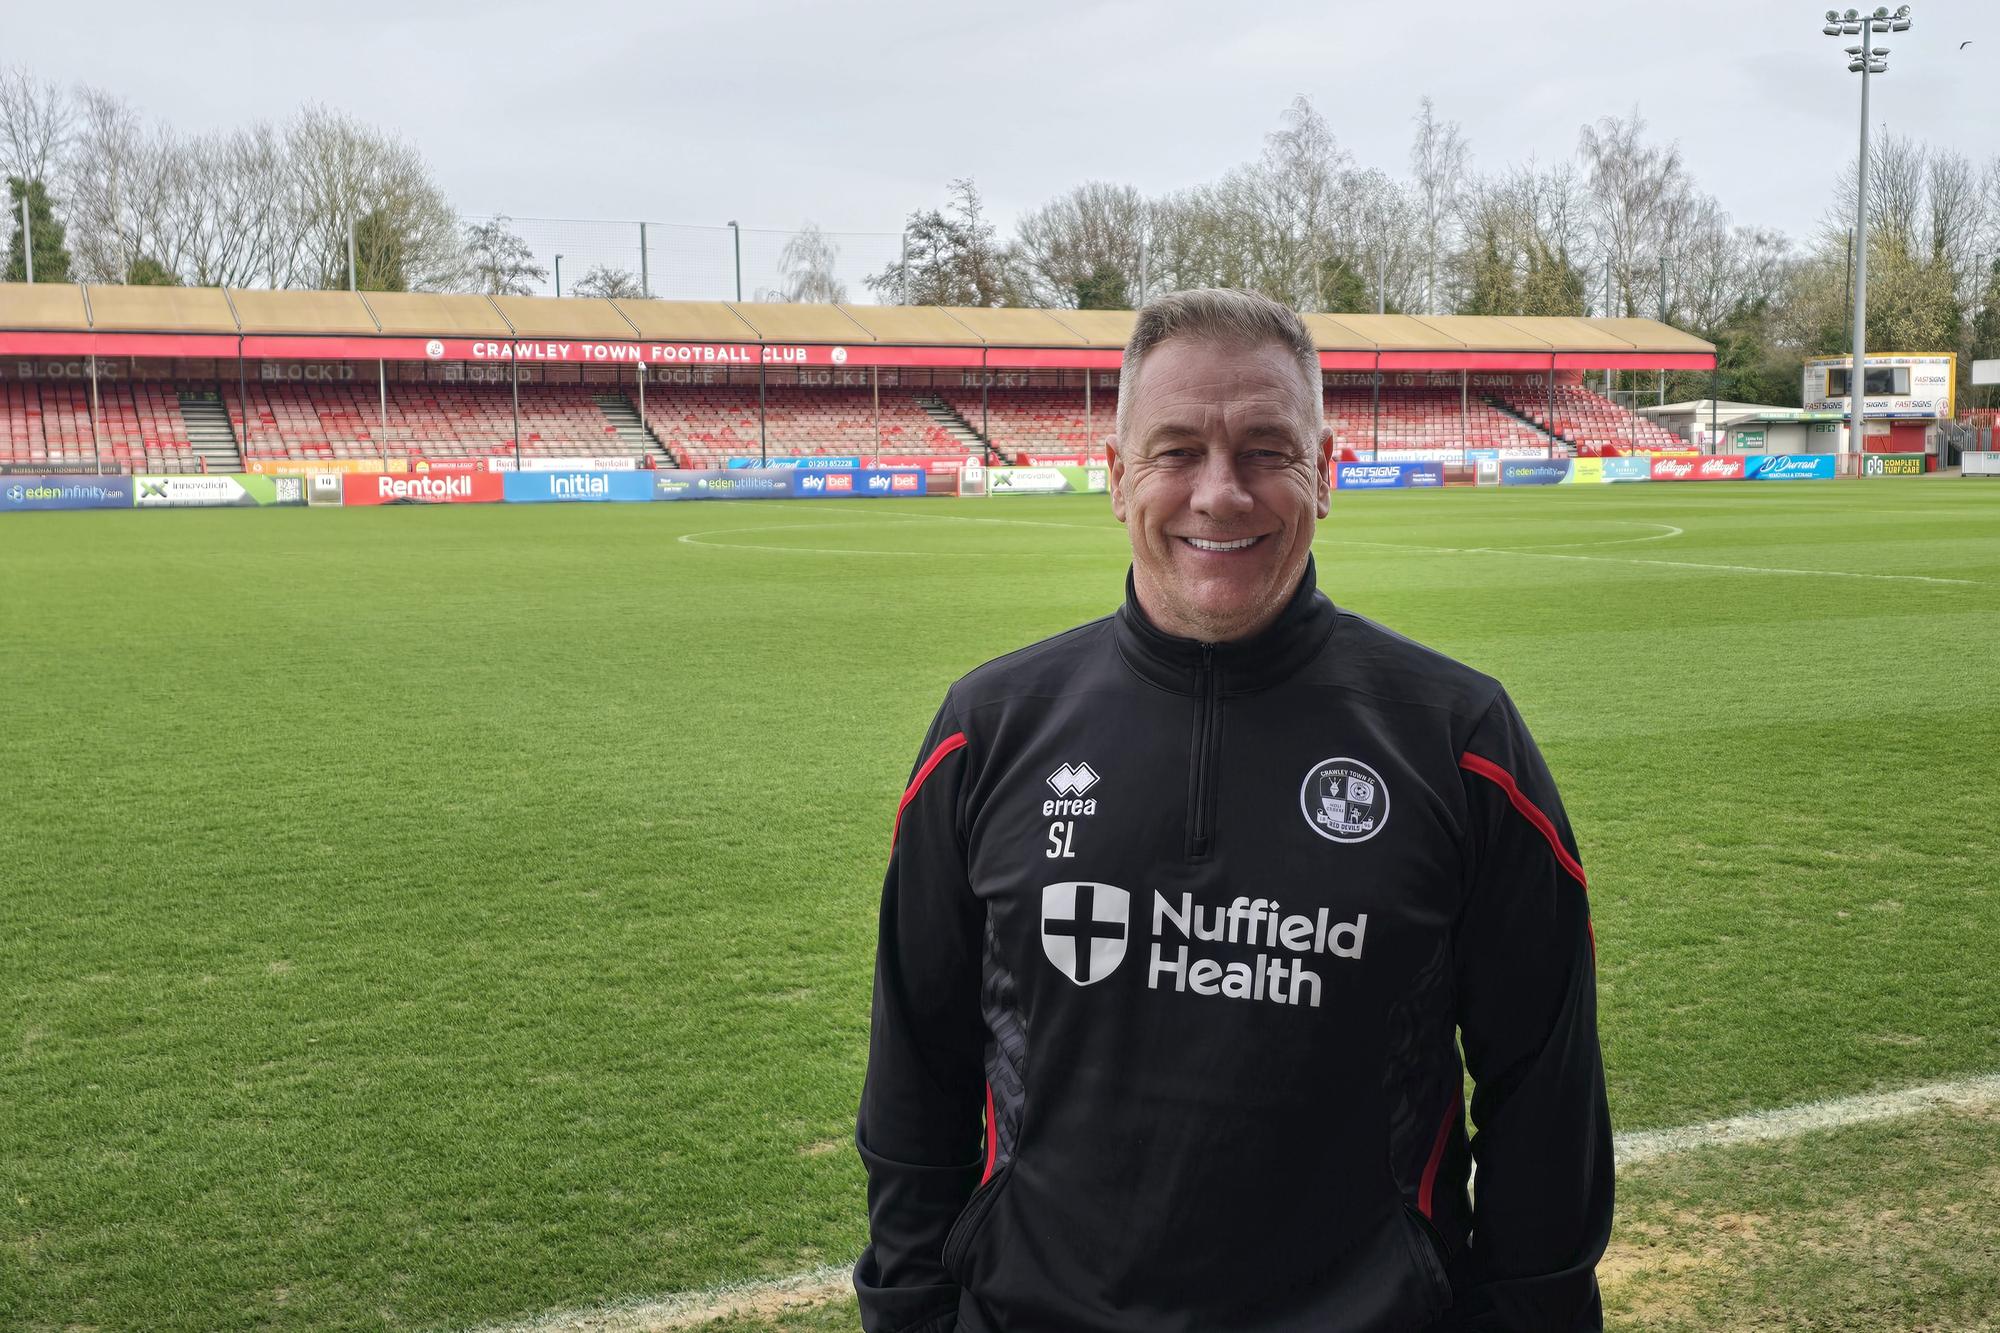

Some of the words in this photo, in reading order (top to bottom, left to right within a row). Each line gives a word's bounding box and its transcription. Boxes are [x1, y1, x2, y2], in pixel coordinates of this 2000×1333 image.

[473, 343, 570, 358] CRAWLEY
[582, 344, 640, 359] TOWN
[652, 346, 750, 361] FOOTBALL
[762, 347, 807, 361] CLUB
[261, 363, 333, 380] BLOCK
[339, 365, 353, 379] D
[1343, 373, 1385, 385] STAND
[1473, 374, 1513, 386] STAND
[1526, 373, 1542, 387] (H)
[1805, 401, 1843, 409] FASTSIGNS
[1894, 400, 1932, 408] FASTSIGNS
[1342, 466, 1400, 477] FASTSIGNS
[1655, 459, 1694, 476] Kellogg's
[1702, 459, 1741, 476] Kellogg's
[1760, 456, 1777, 472] D
[1775, 455, 1822, 472] Durrant
[1884, 466, 1900, 474] TURF
[1902, 466, 1920, 474] CARE
[378, 475, 472, 496] Rentokil
[550, 473, 609, 494] Initial
[802, 474, 825, 490] sky
[827, 475, 850, 487] bet
[869, 474, 891, 490] sky
[894, 475, 916, 486] bet
[25, 485, 122, 500] edeninfinity.com
[1320, 769, 1348, 777] CRAWLEY
[1349, 770, 1367, 781] TOWN
[1366, 777, 1376, 785] FC
[1329, 820, 1340, 829] RED
[1341, 824, 1360, 832] DEVILS
[1046, 821, 1075, 858] SL
[1152, 888, 1368, 960] Nuffield
[1148, 942, 1322, 1008] Health
